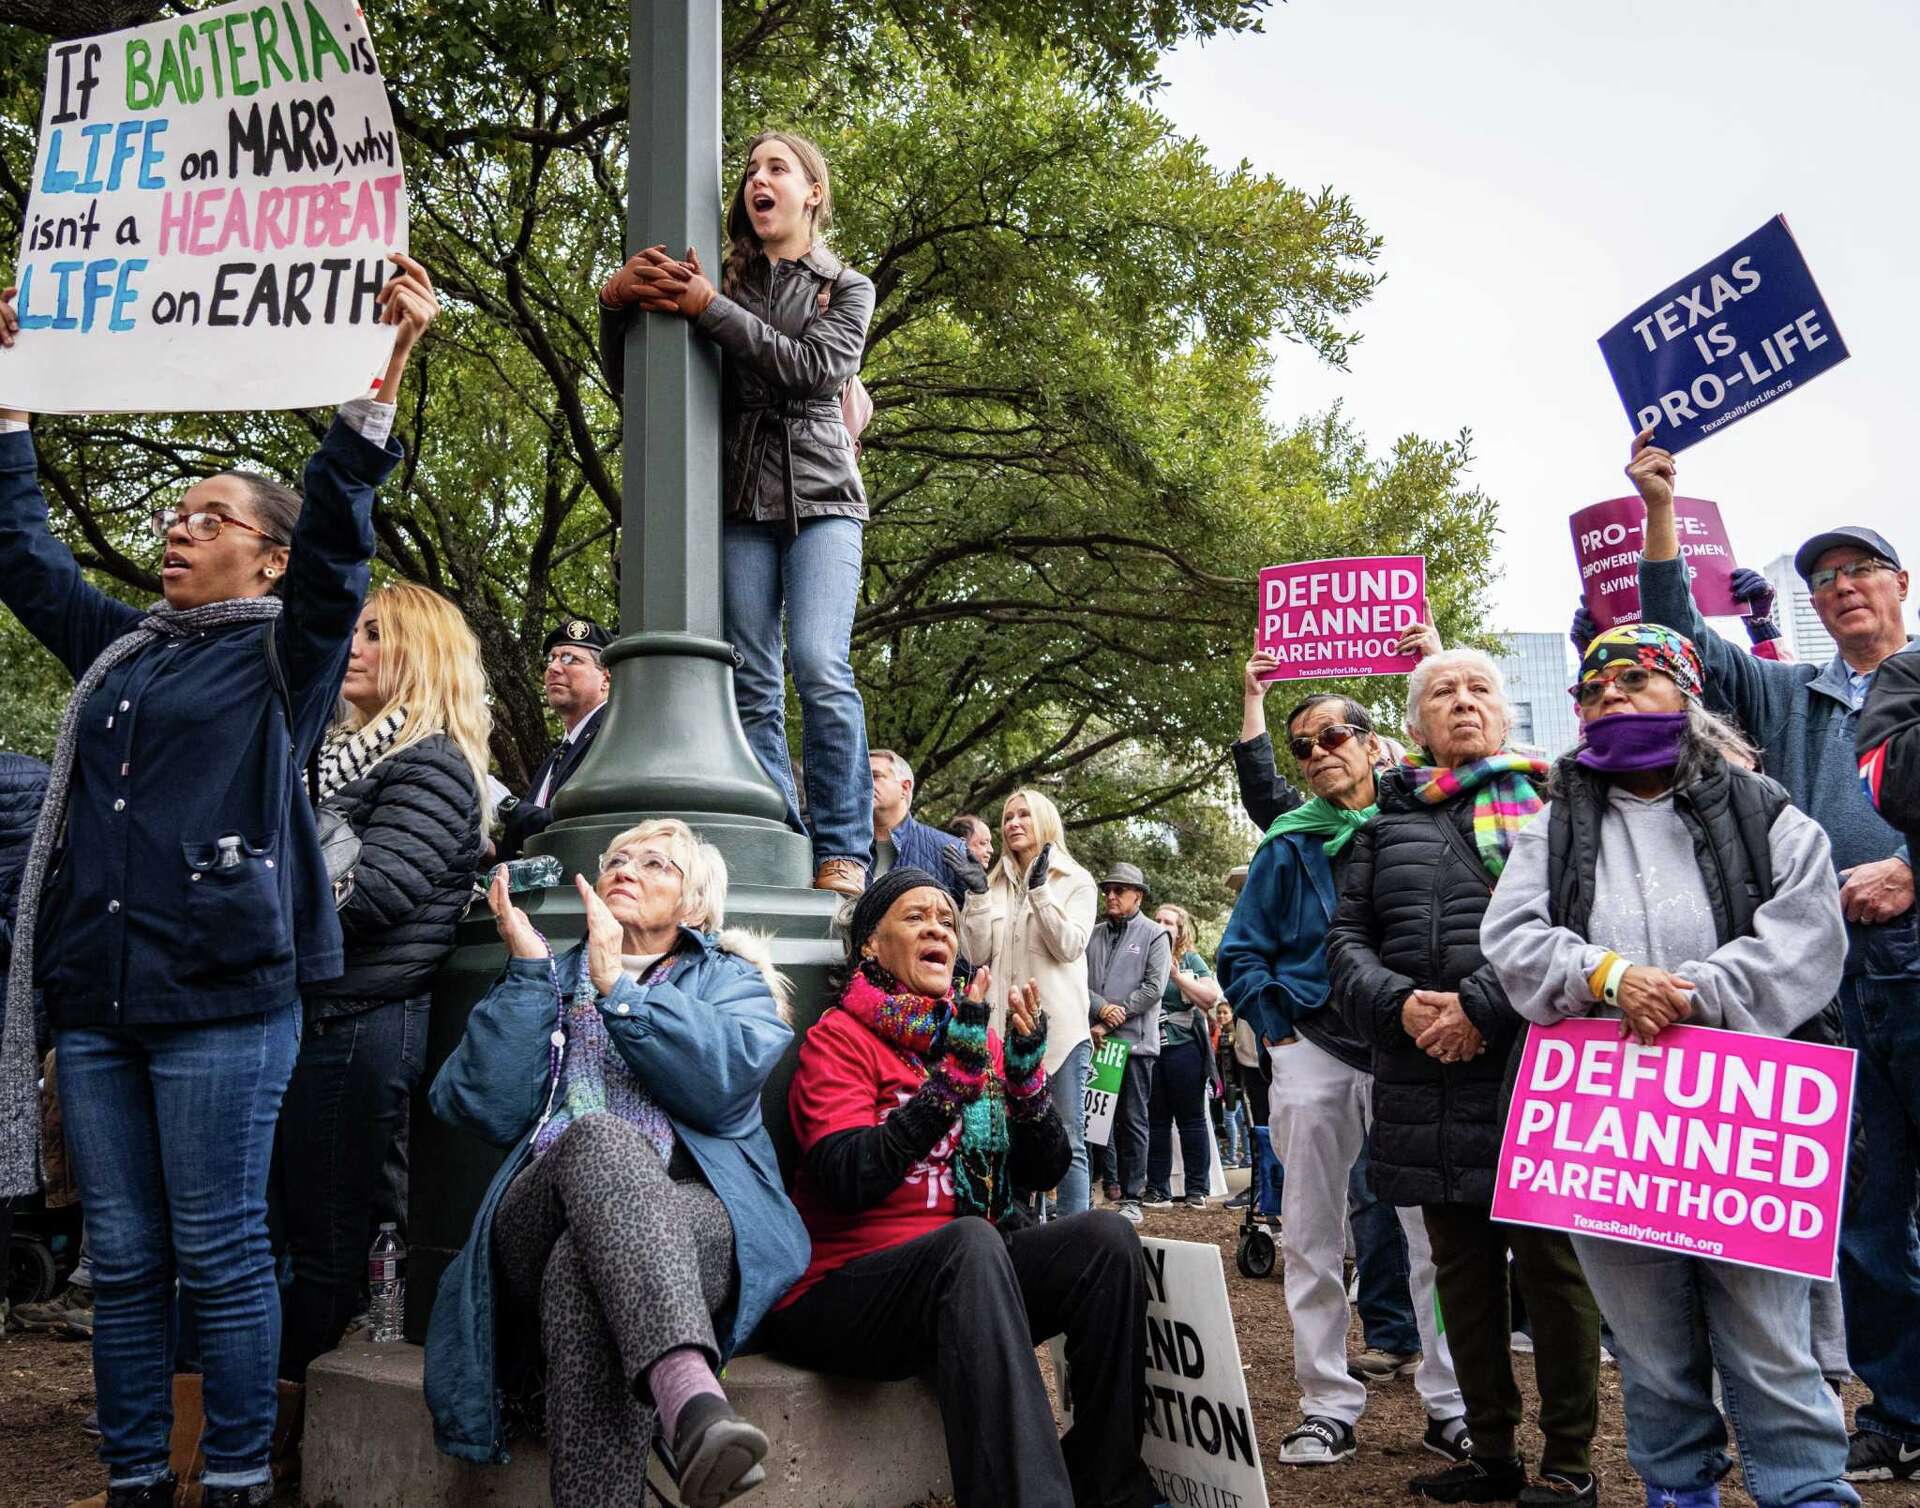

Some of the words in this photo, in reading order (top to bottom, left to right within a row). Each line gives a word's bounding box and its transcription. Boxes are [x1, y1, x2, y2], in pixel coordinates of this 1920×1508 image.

[50, 43, 101, 125] If
[125, 0, 350, 110] BACTERIA
[344, 23, 376, 76] is
[40, 119, 168, 194] LIFE
[181, 147, 218, 181] on
[228, 95, 344, 178] MARS,
[344, 116, 395, 168] why
[29, 199, 100, 251] isn't
[115, 214, 140, 246] a
[158, 174, 402, 256] HEARTBEAT
[17, 258, 149, 333] LIFE
[152, 286, 200, 326] on
[207, 257, 405, 327] EARTH
[1632, 255, 1761, 353] TEXAS
[1637, 309, 1828, 440] PRO-LIFE
[1694, 322, 1737, 365] IS
[1700, 379, 1793, 434] TexasRallyforLife.org
[1265, 569, 1417, 611] DEFUND
[1583, 550, 1642, 579] EMPOWERIN
[1682, 544, 1728, 557] OMEN,
[1264, 604, 1417, 641] PLANNED
[1264, 638, 1416, 664] PARENTHOO
[1299, 665, 1372, 677] TexasRallyforLife.org
[1084, 1089, 1109, 1116] OSE
[1529, 1038, 1838, 1127] DEFUND
[1516, 1098, 1830, 1189] PLANNED
[1508, 1155, 1824, 1240] PARENTHOOD
[1573, 1213, 1723, 1255] TexasRallyforLife.org
[1146, 1316, 1205, 1380] ND
